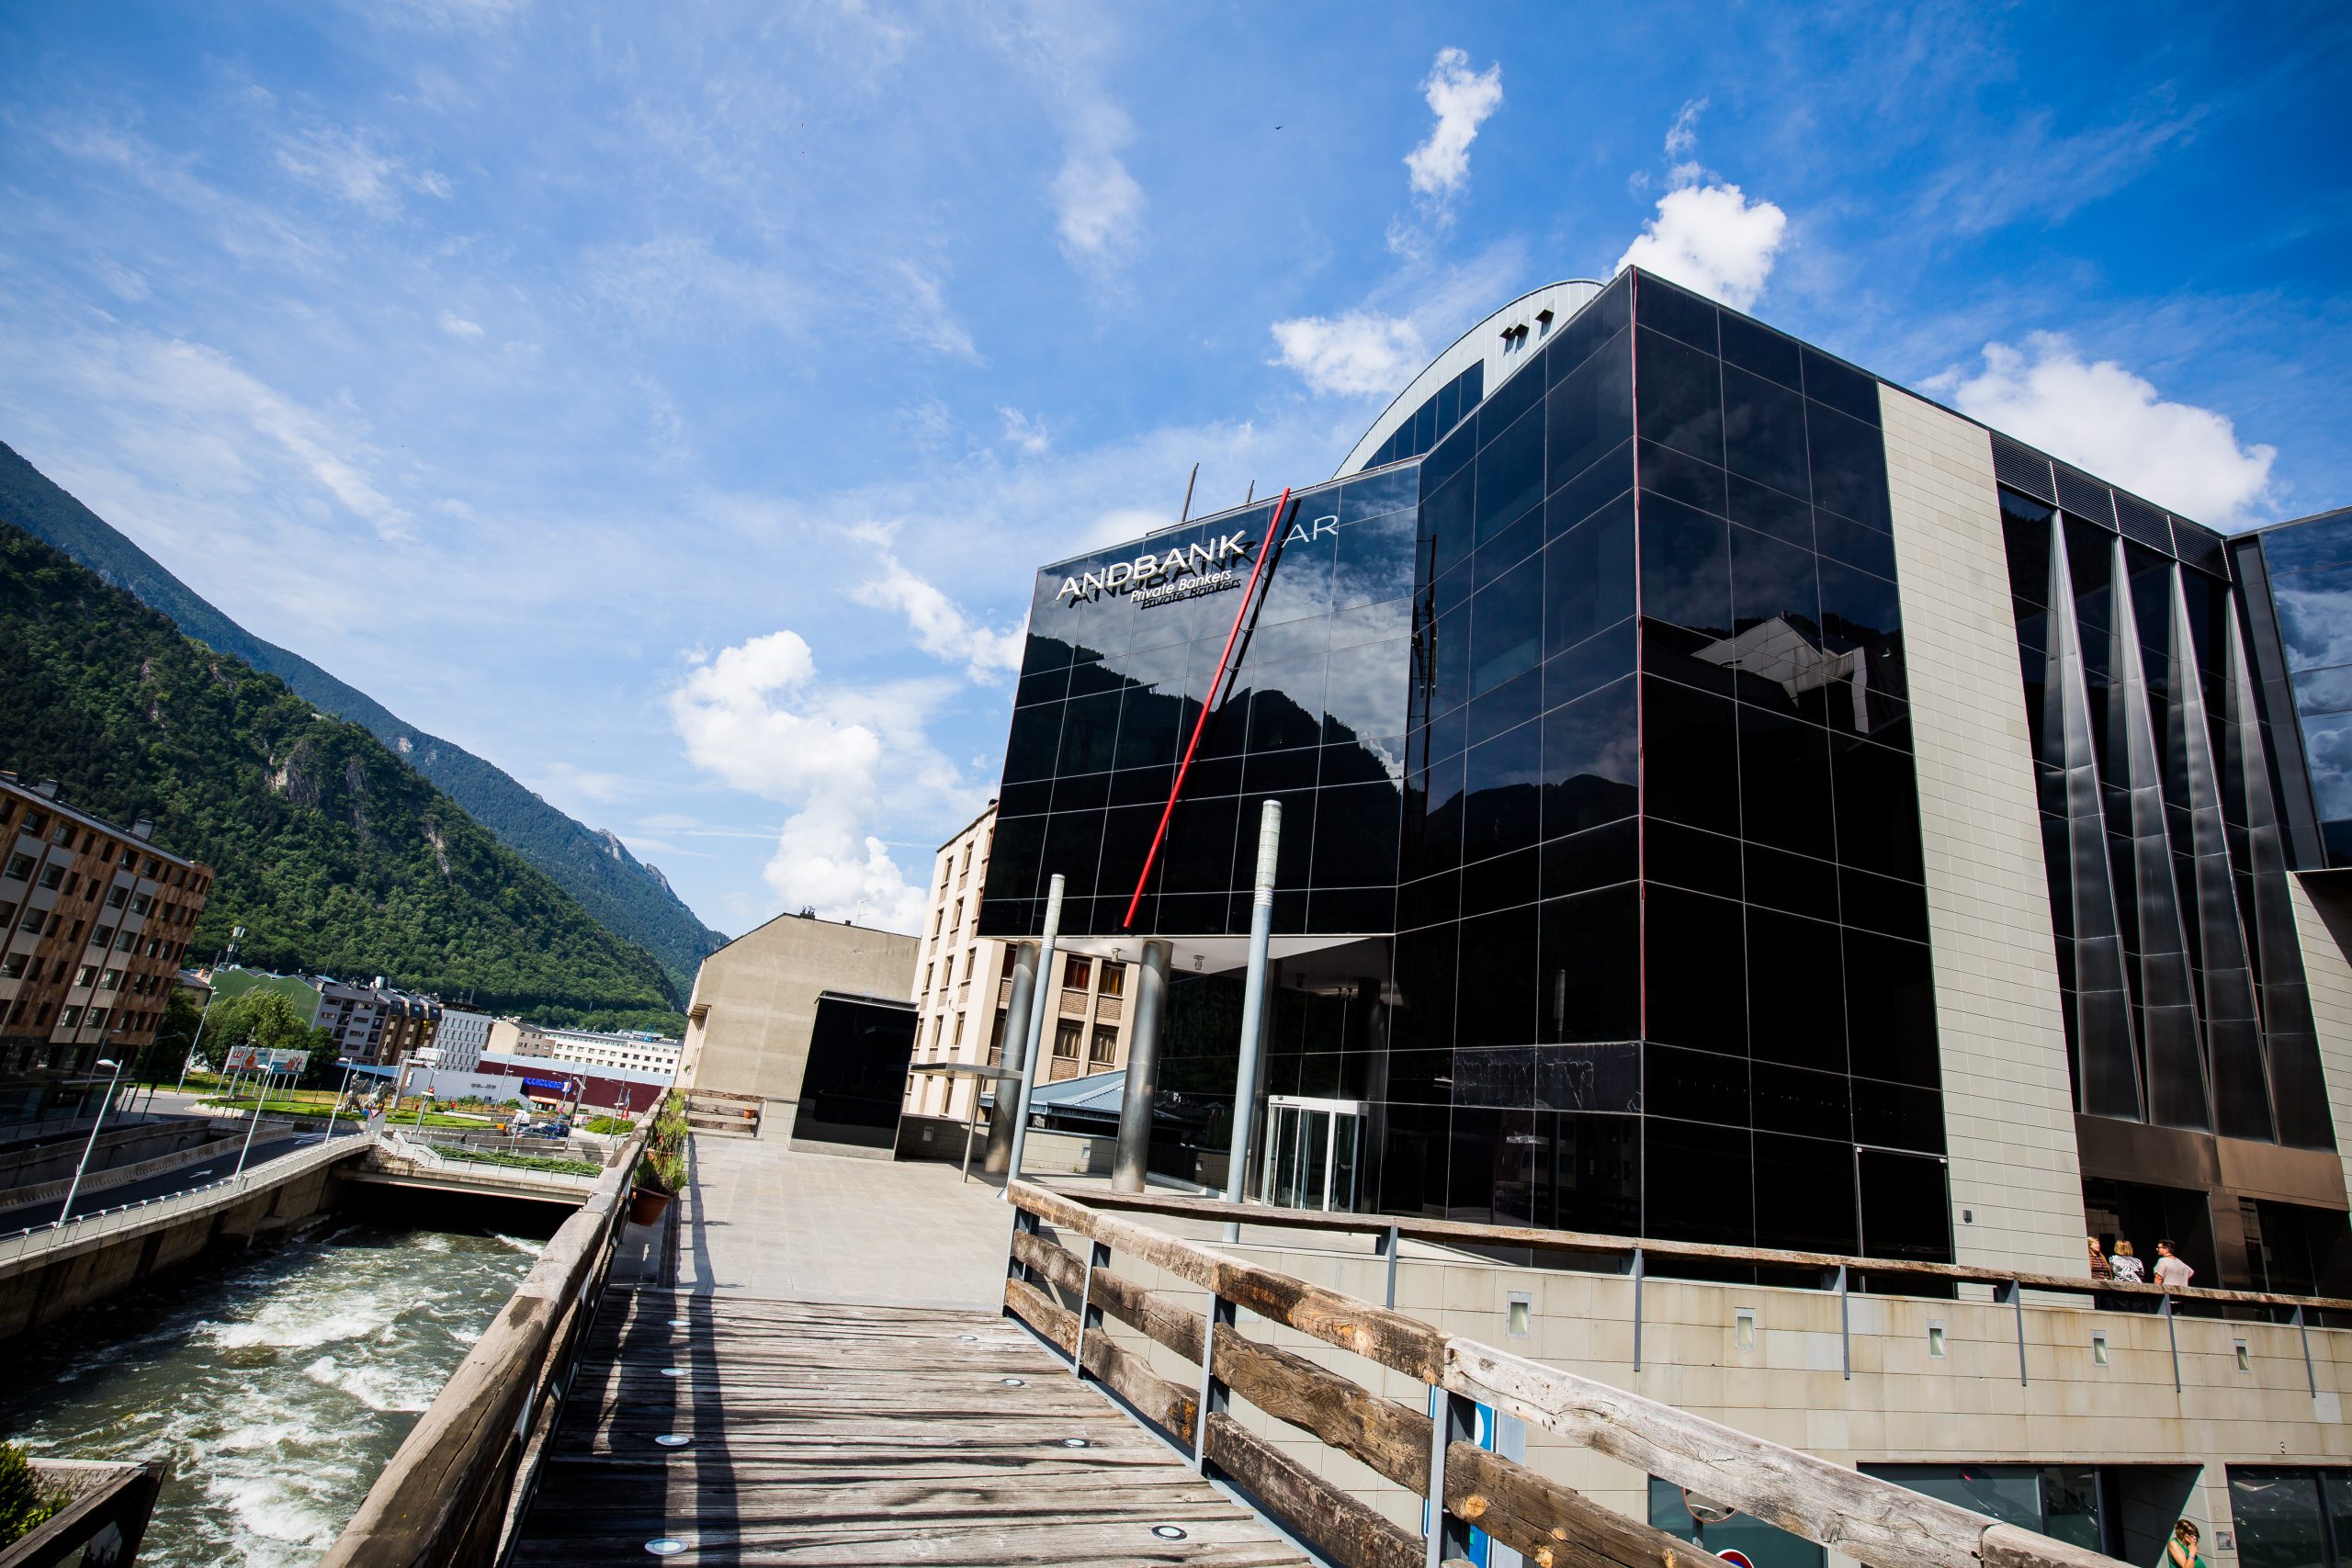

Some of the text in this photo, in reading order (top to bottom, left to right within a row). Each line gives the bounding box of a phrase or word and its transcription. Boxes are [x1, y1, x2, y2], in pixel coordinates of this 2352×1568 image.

[1281, 515, 1338, 548] AR
[1056, 530, 1247, 600] ANDBANK
[1130, 570, 1232, 604] Private Bankers
